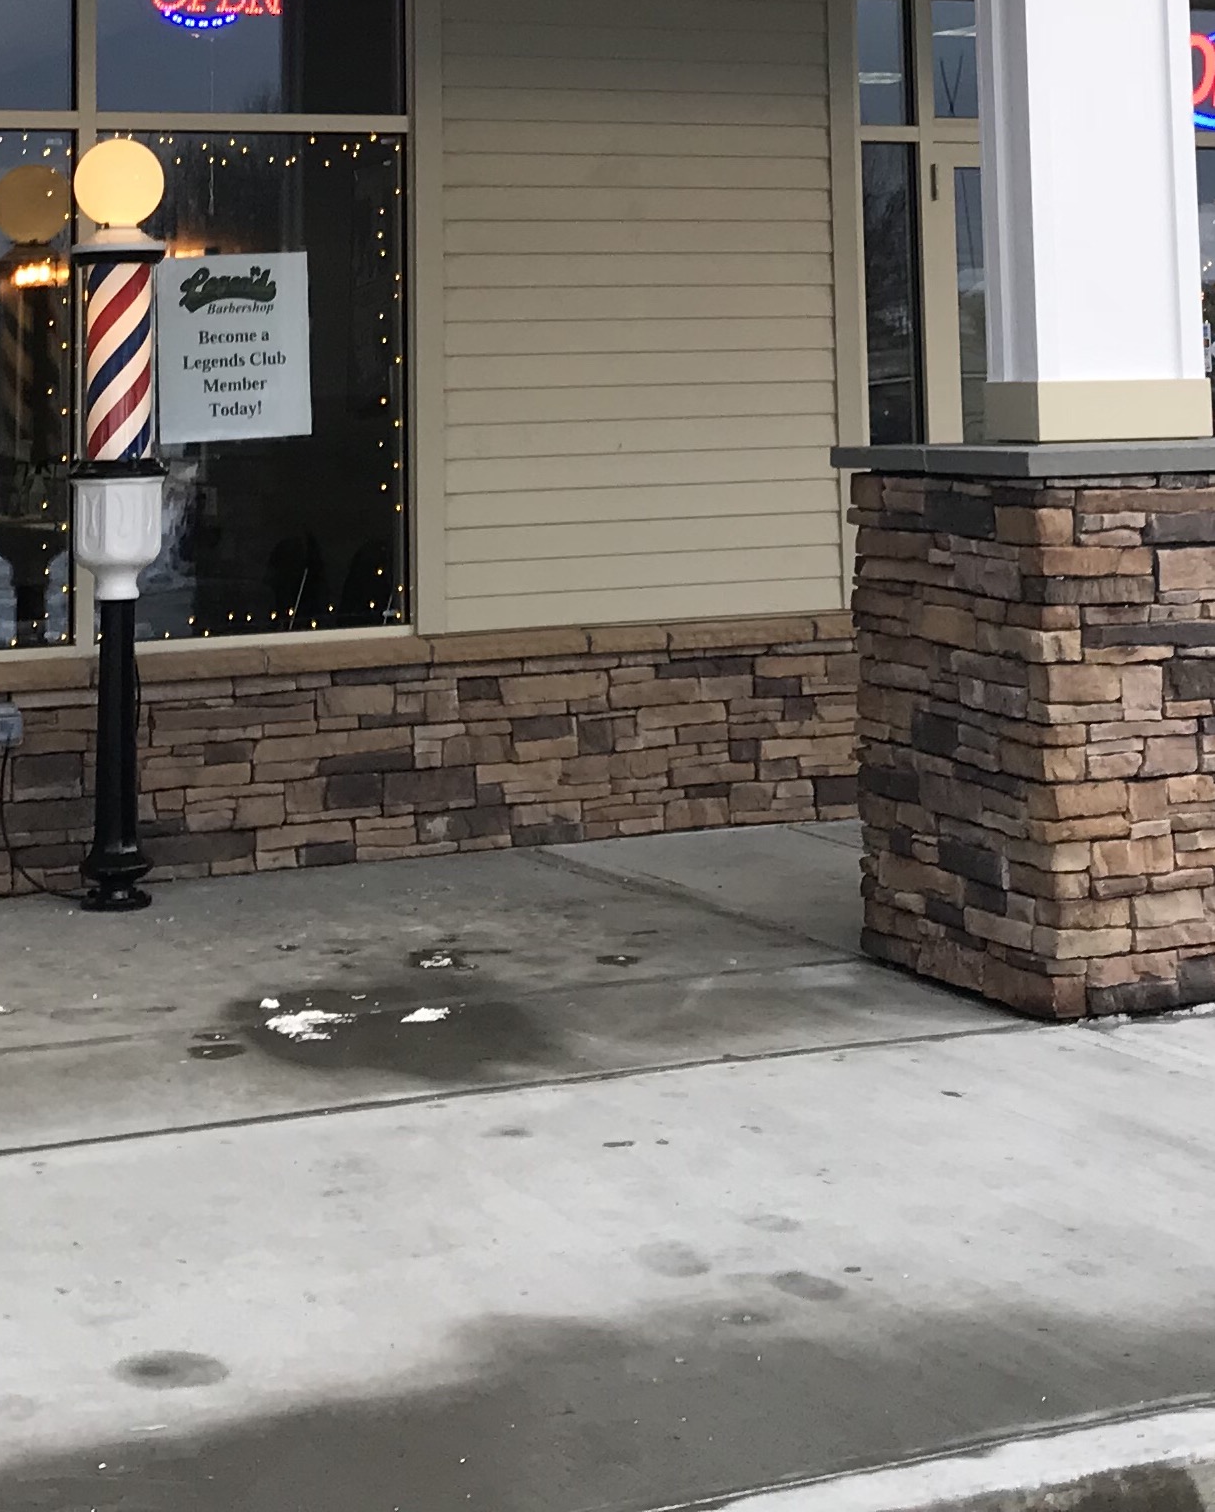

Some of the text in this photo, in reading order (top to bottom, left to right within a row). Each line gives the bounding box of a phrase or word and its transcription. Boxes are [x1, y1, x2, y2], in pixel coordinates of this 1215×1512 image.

[207, 302, 275, 315] Barbershop
[198, 330, 270, 345] Become a
[183, 351, 286, 373] Legends Club
[203, 377, 268, 393] Member
[209, 400, 262, 418] Today!
